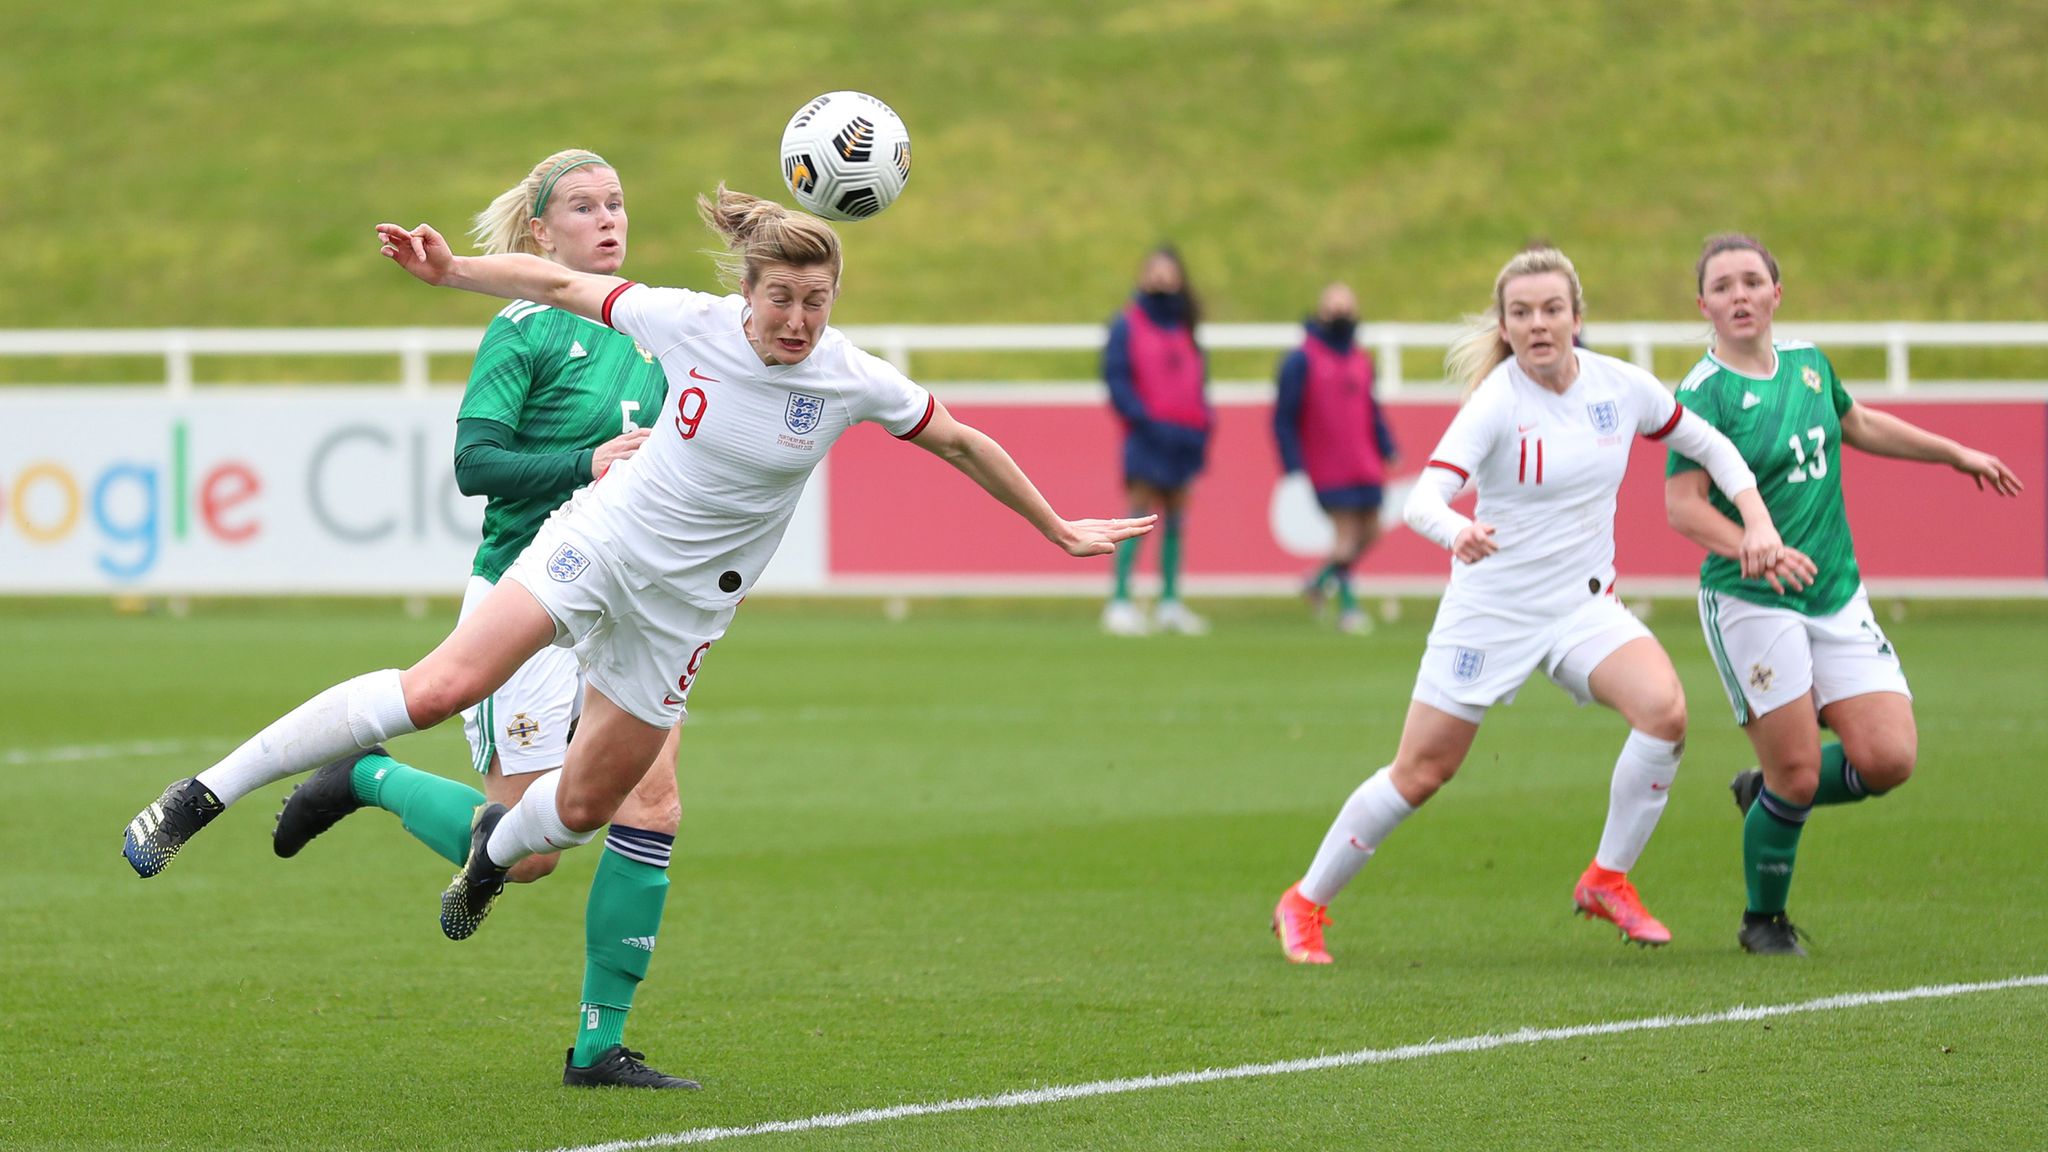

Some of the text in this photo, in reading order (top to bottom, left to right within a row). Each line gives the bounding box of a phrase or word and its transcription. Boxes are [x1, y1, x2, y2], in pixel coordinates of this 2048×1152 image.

[620, 400, 640, 434] 5
[675, 387, 708, 440] 9
[1518, 437, 1543, 486] 11
[1787, 427, 1827, 483] 13
[0, 418, 262, 581] ogle
